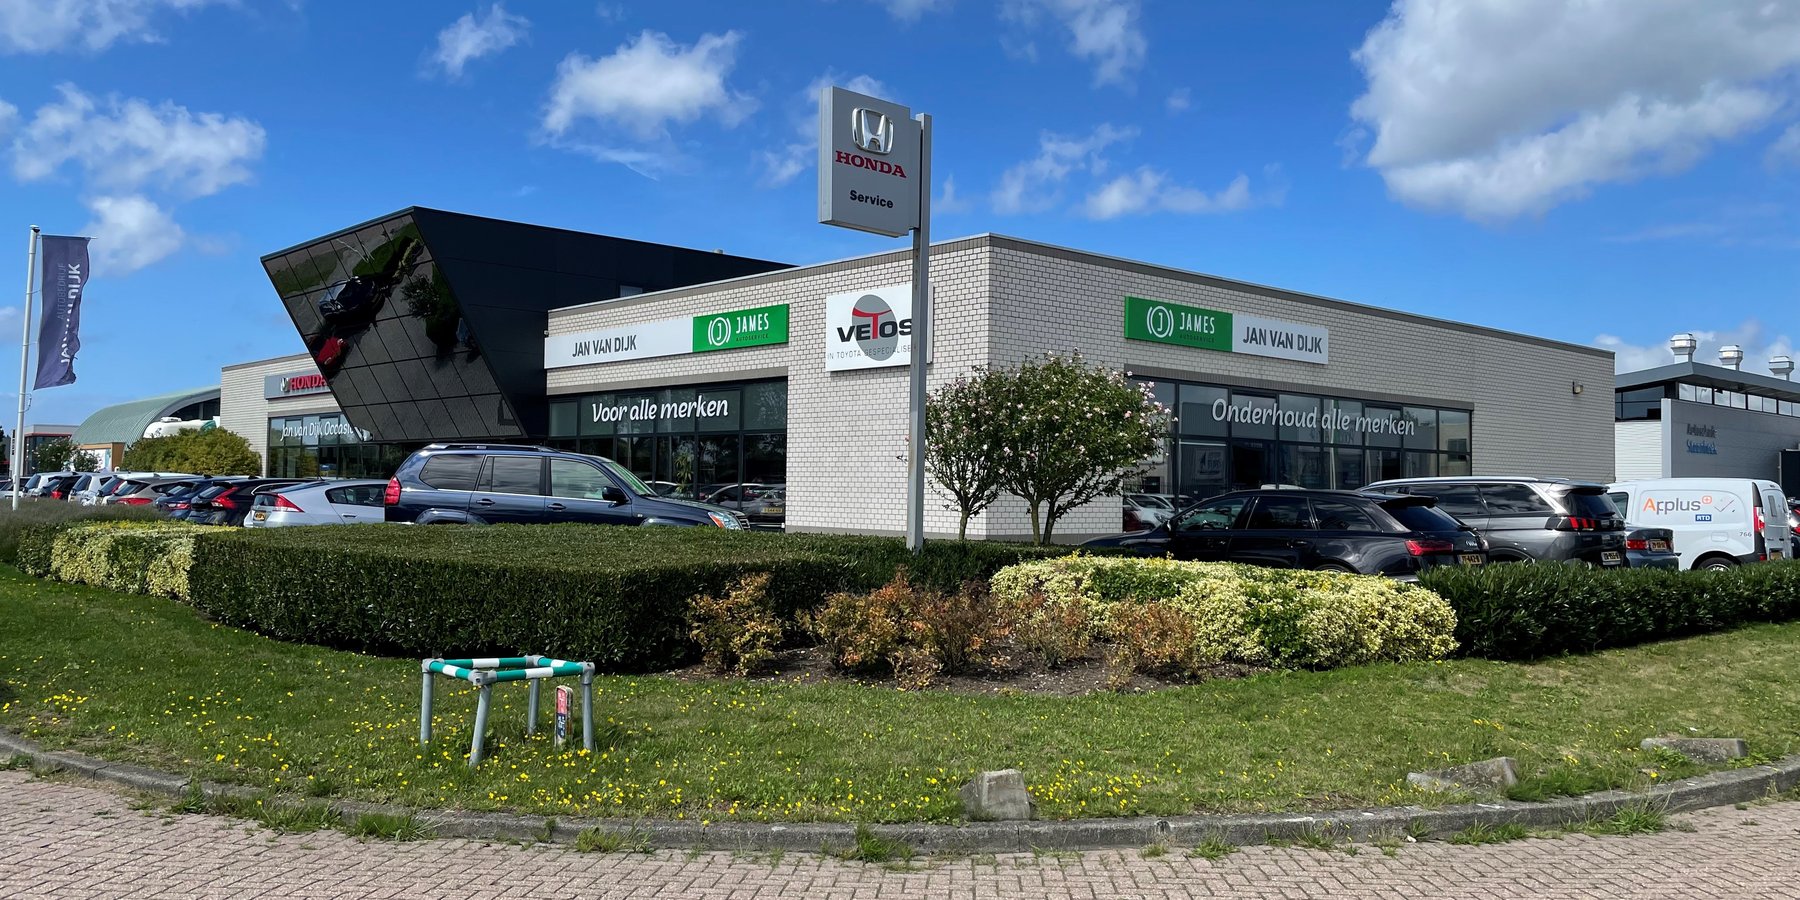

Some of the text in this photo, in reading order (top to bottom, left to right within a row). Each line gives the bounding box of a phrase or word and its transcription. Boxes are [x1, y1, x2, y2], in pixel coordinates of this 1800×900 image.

[835, 150, 907, 179] HONDA
[849, 189, 894, 209] Service
[735, 313, 769, 334] JAMES
[836, 307, 913, 343] VETOS
[1179, 312, 1215, 334] JAMES
[572, 334, 637, 358] JAN VAN DIJK
[1243, 326, 1323, 354] JAN VAN DIJK
[836, 350, 862, 359] TOYOTA
[864, 345, 912, 356] GESPECIALISE
[289, 374, 328, 391] HONDA
[592, 394, 729, 423] Voor alle merken
[1211, 397, 1415, 436] Onderhoud alle merken
[280, 424, 293, 441] Jan
[294, 424, 308, 437] van
[309, 420, 323, 438] Dijk
